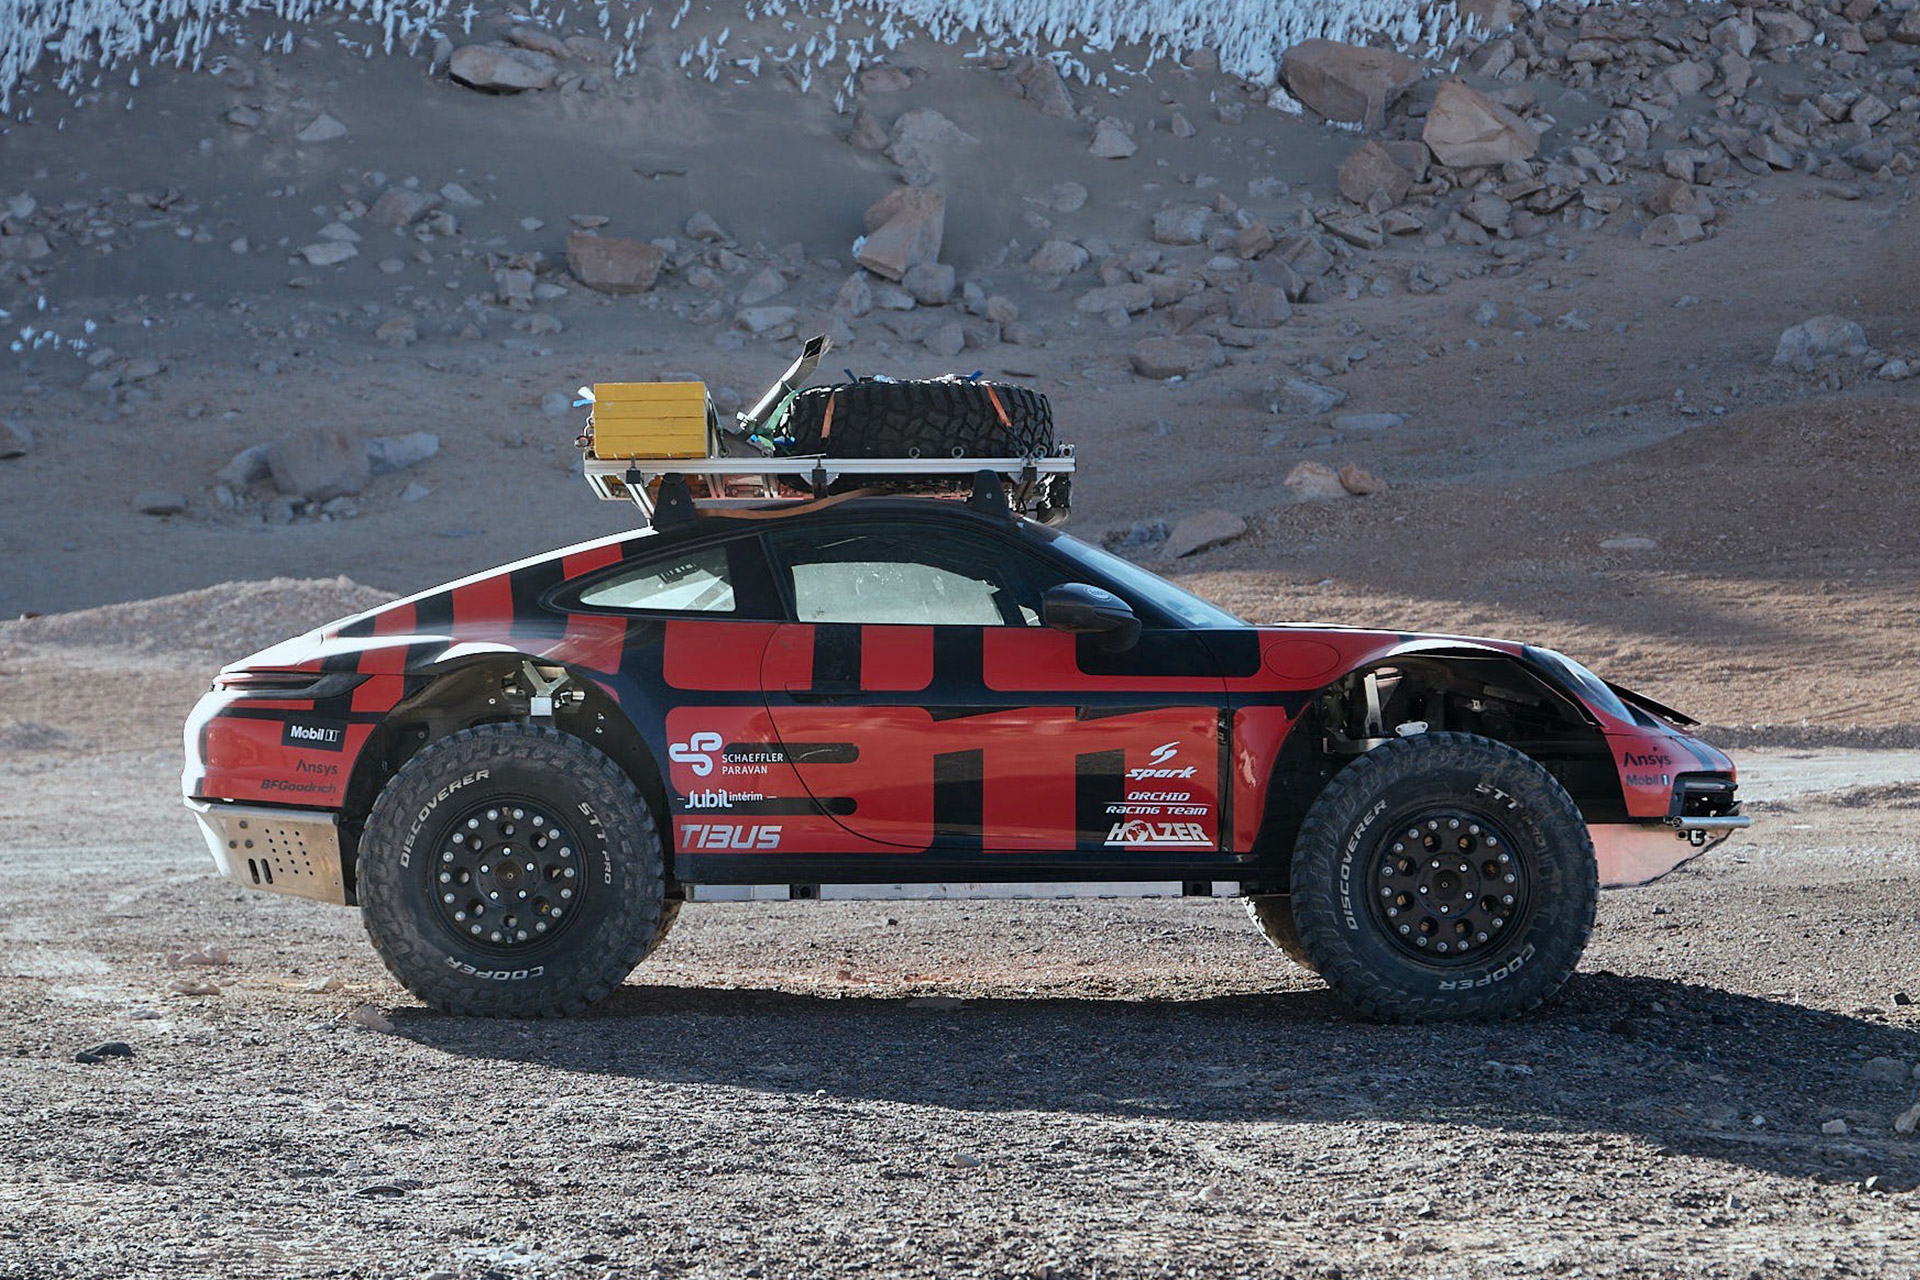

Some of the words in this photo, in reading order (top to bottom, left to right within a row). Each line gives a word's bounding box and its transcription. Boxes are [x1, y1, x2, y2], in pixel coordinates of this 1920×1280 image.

[290, 725, 325, 741] Mobil
[721, 752, 784, 763] SCHAEFFLER
[1623, 752, 1672, 768] Ansys
[296, 759, 338, 776] Ansys
[722, 765, 767, 775] PARAVAN
[1125, 766, 1198, 781] spark
[261, 779, 337, 793] BFGoodrich
[1626, 774, 1660, 786] Mobil
[1127, 791, 1191, 801] ORCHID
[400, 769, 489, 868] DISCOVERER
[680, 824, 782, 849] TIBUS
[1340, 799, 1388, 930] DISCOVERER
[444, 956, 544, 981] COOPER
[1439, 943, 1536, 991] COOPER
